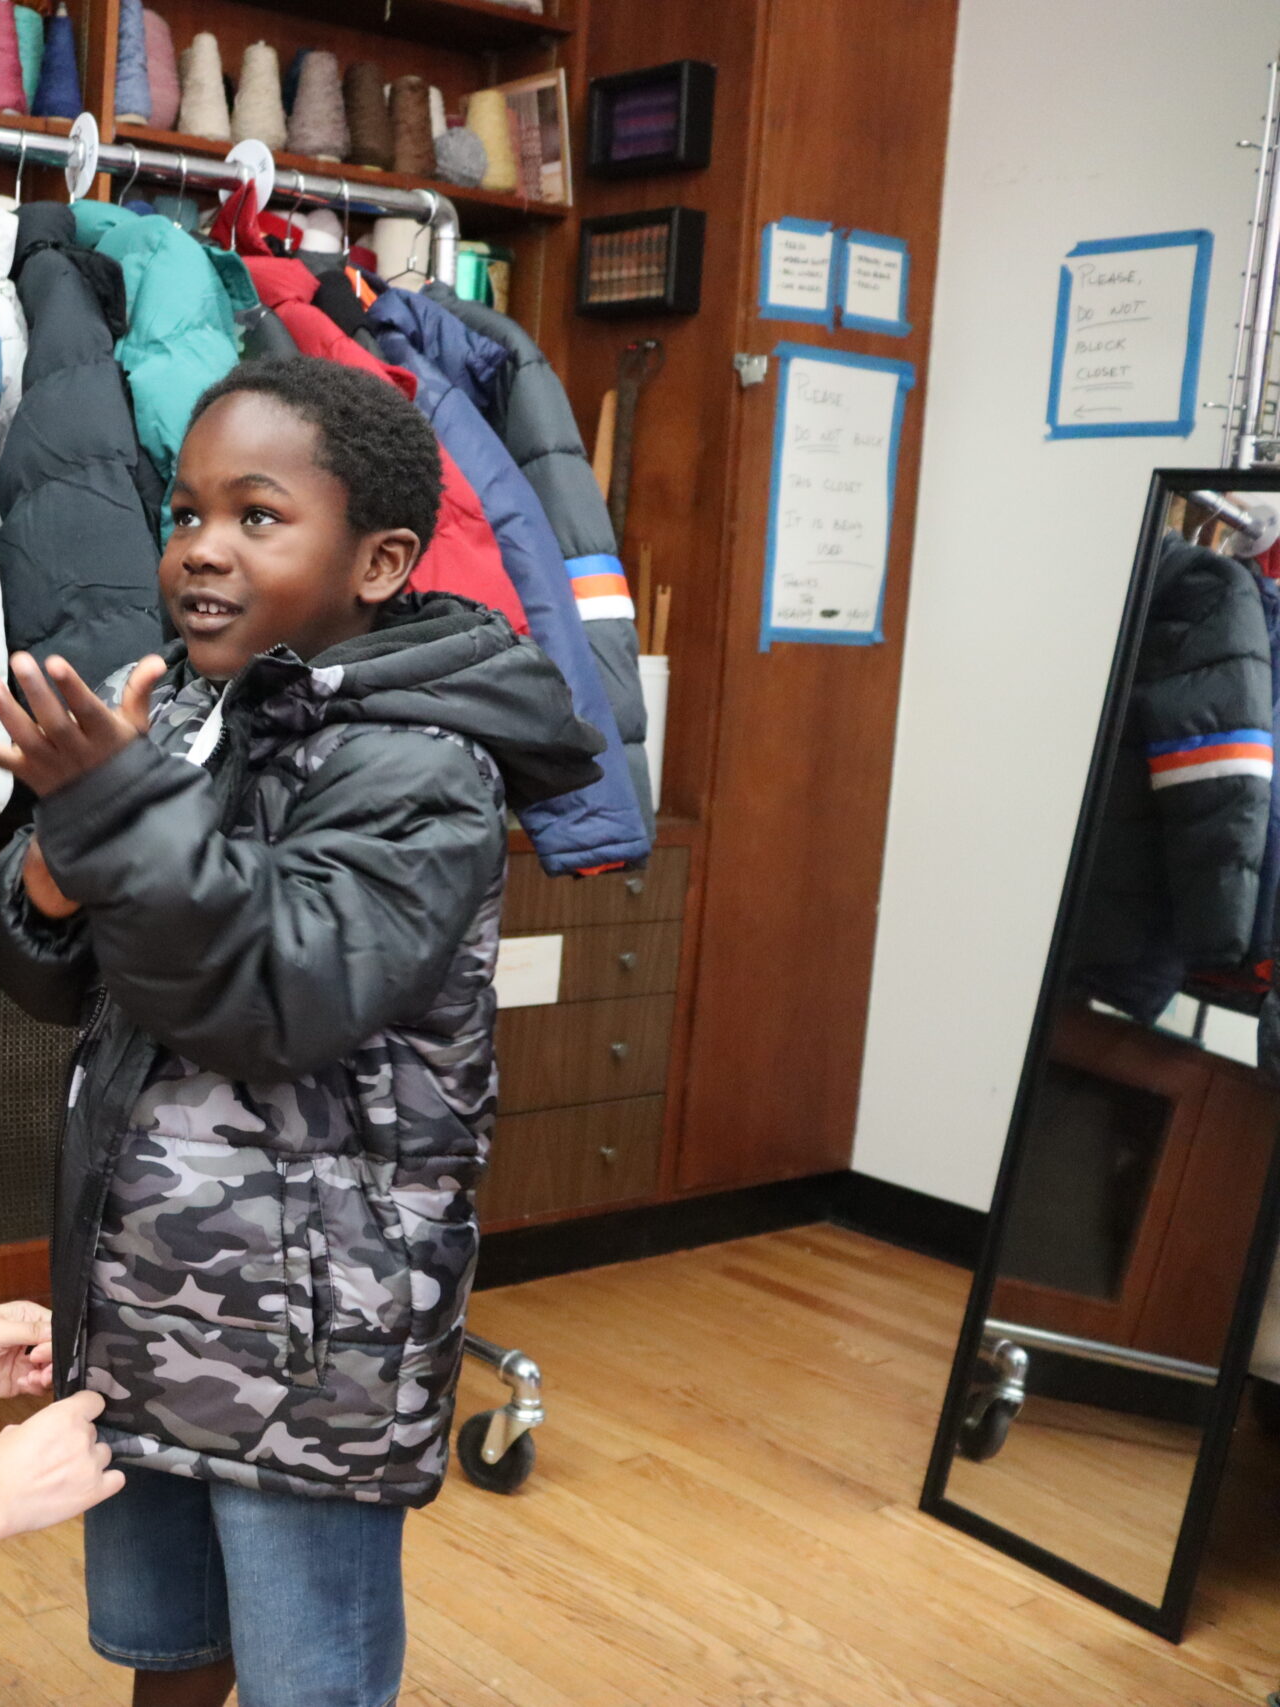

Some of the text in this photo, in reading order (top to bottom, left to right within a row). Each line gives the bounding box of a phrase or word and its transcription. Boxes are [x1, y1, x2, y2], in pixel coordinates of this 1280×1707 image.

[1076, 299, 1148, 323] DO NOT
[1075, 338, 1128, 354] BLOCK
[1076, 364, 1132, 380] CLOSET
[793, 424, 810, 443] DO
[821, 427, 844, 443] NOT
[823, 477, 864, 494] CLOSET
